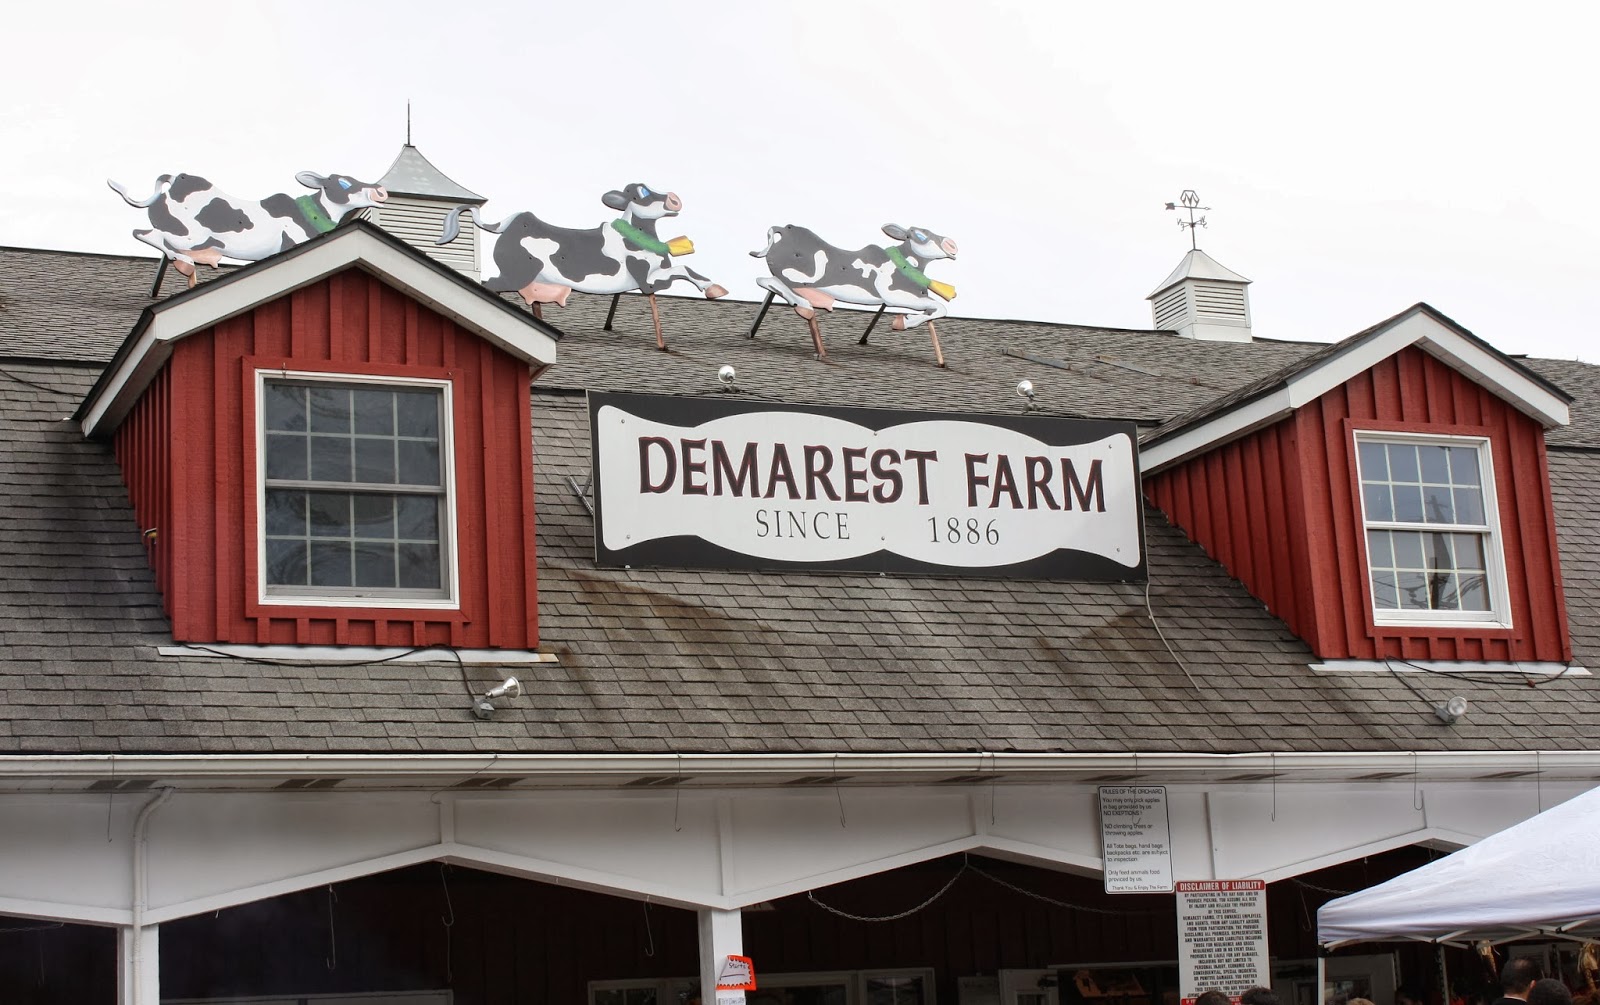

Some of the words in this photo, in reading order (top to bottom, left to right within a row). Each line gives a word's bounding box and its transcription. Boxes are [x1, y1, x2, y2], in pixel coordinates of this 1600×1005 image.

[638, 436, 937, 505] DEMAREST
[965, 452, 1106, 513] FARM
[756, 510, 850, 540] SINCE
[929, 516, 999, 546] 1886
[1180, 882, 1219, 891] DISCLAIMER
[1232, 881, 1261, 889] LIABILITY
